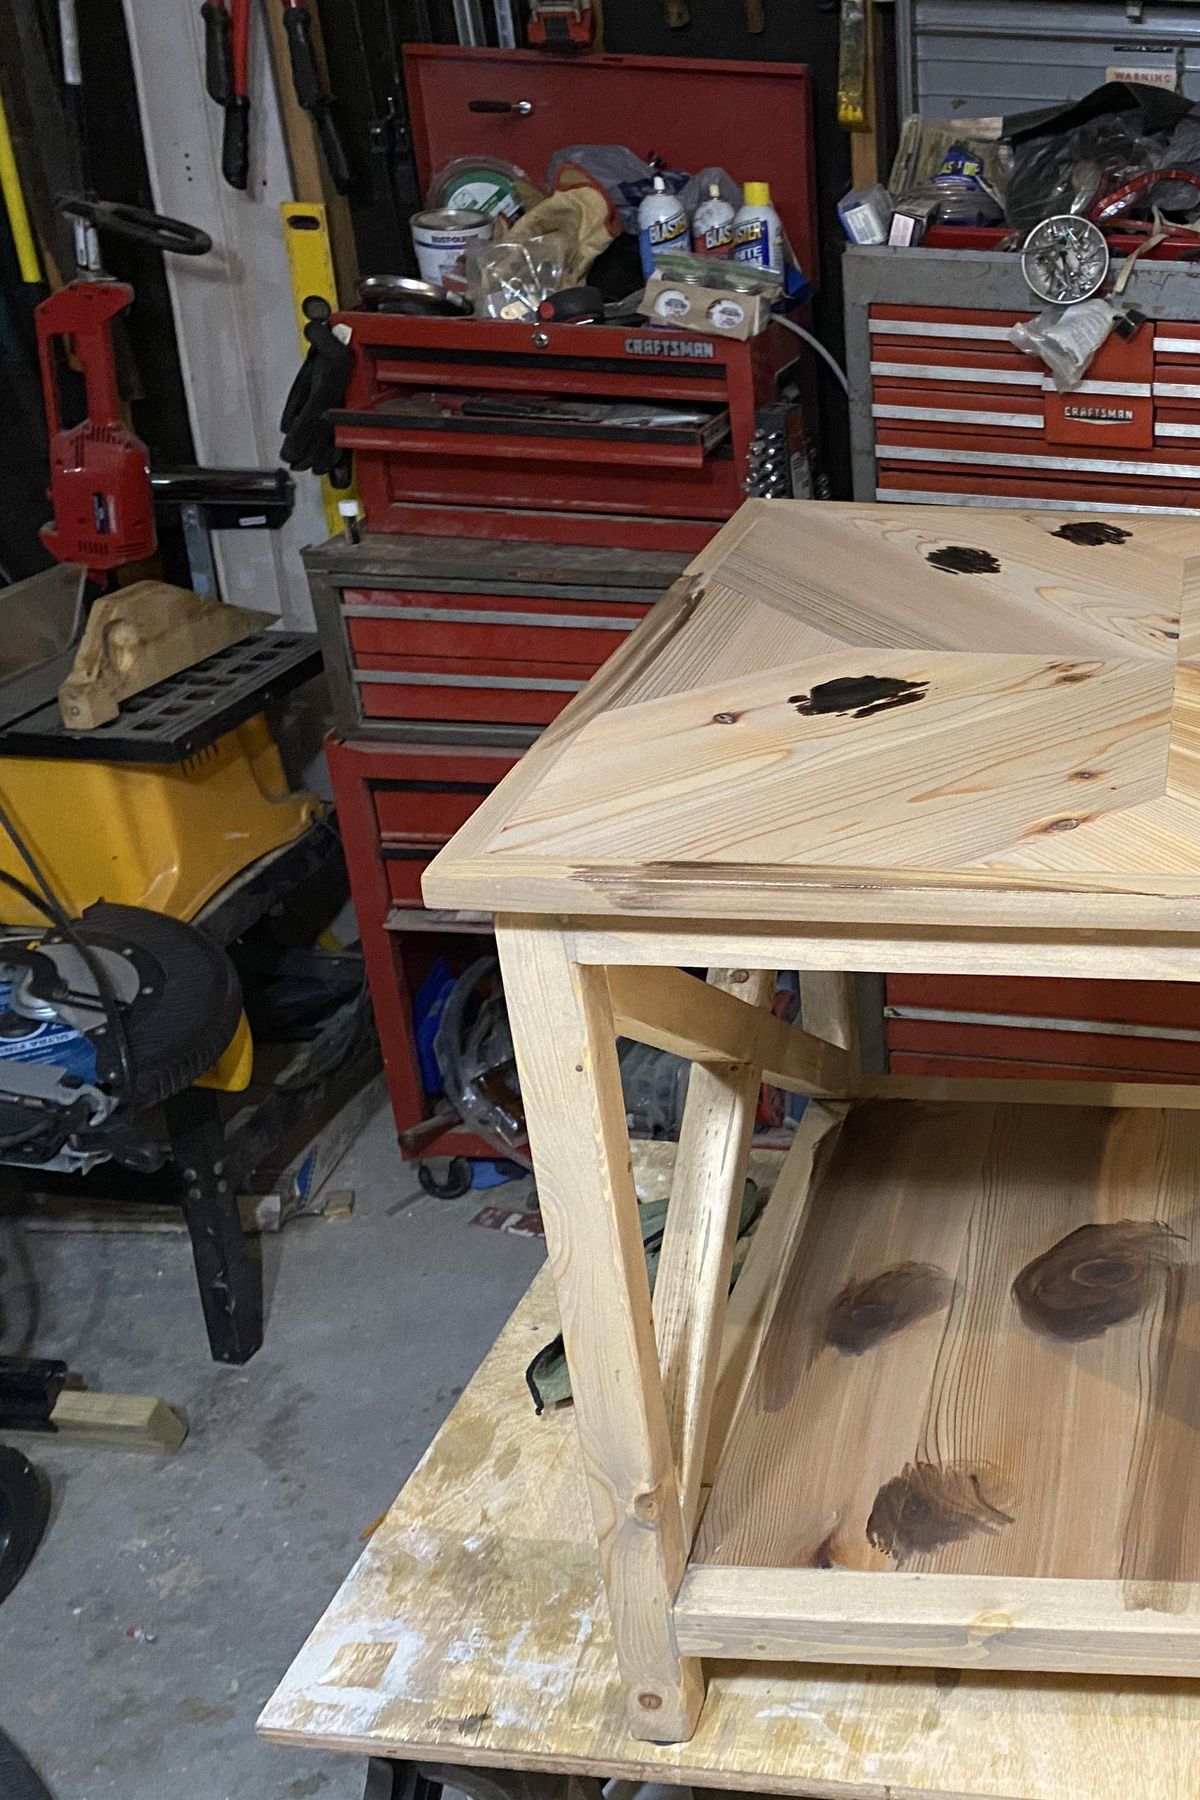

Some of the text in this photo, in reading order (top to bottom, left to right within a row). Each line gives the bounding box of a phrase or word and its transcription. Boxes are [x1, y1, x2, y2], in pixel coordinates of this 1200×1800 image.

[1113, 71, 1172, 84] WARNING
[624, 338, 714, 359] CRAFTSMAN
[1063, 406, 1134, 420] CRAFTSMAN
